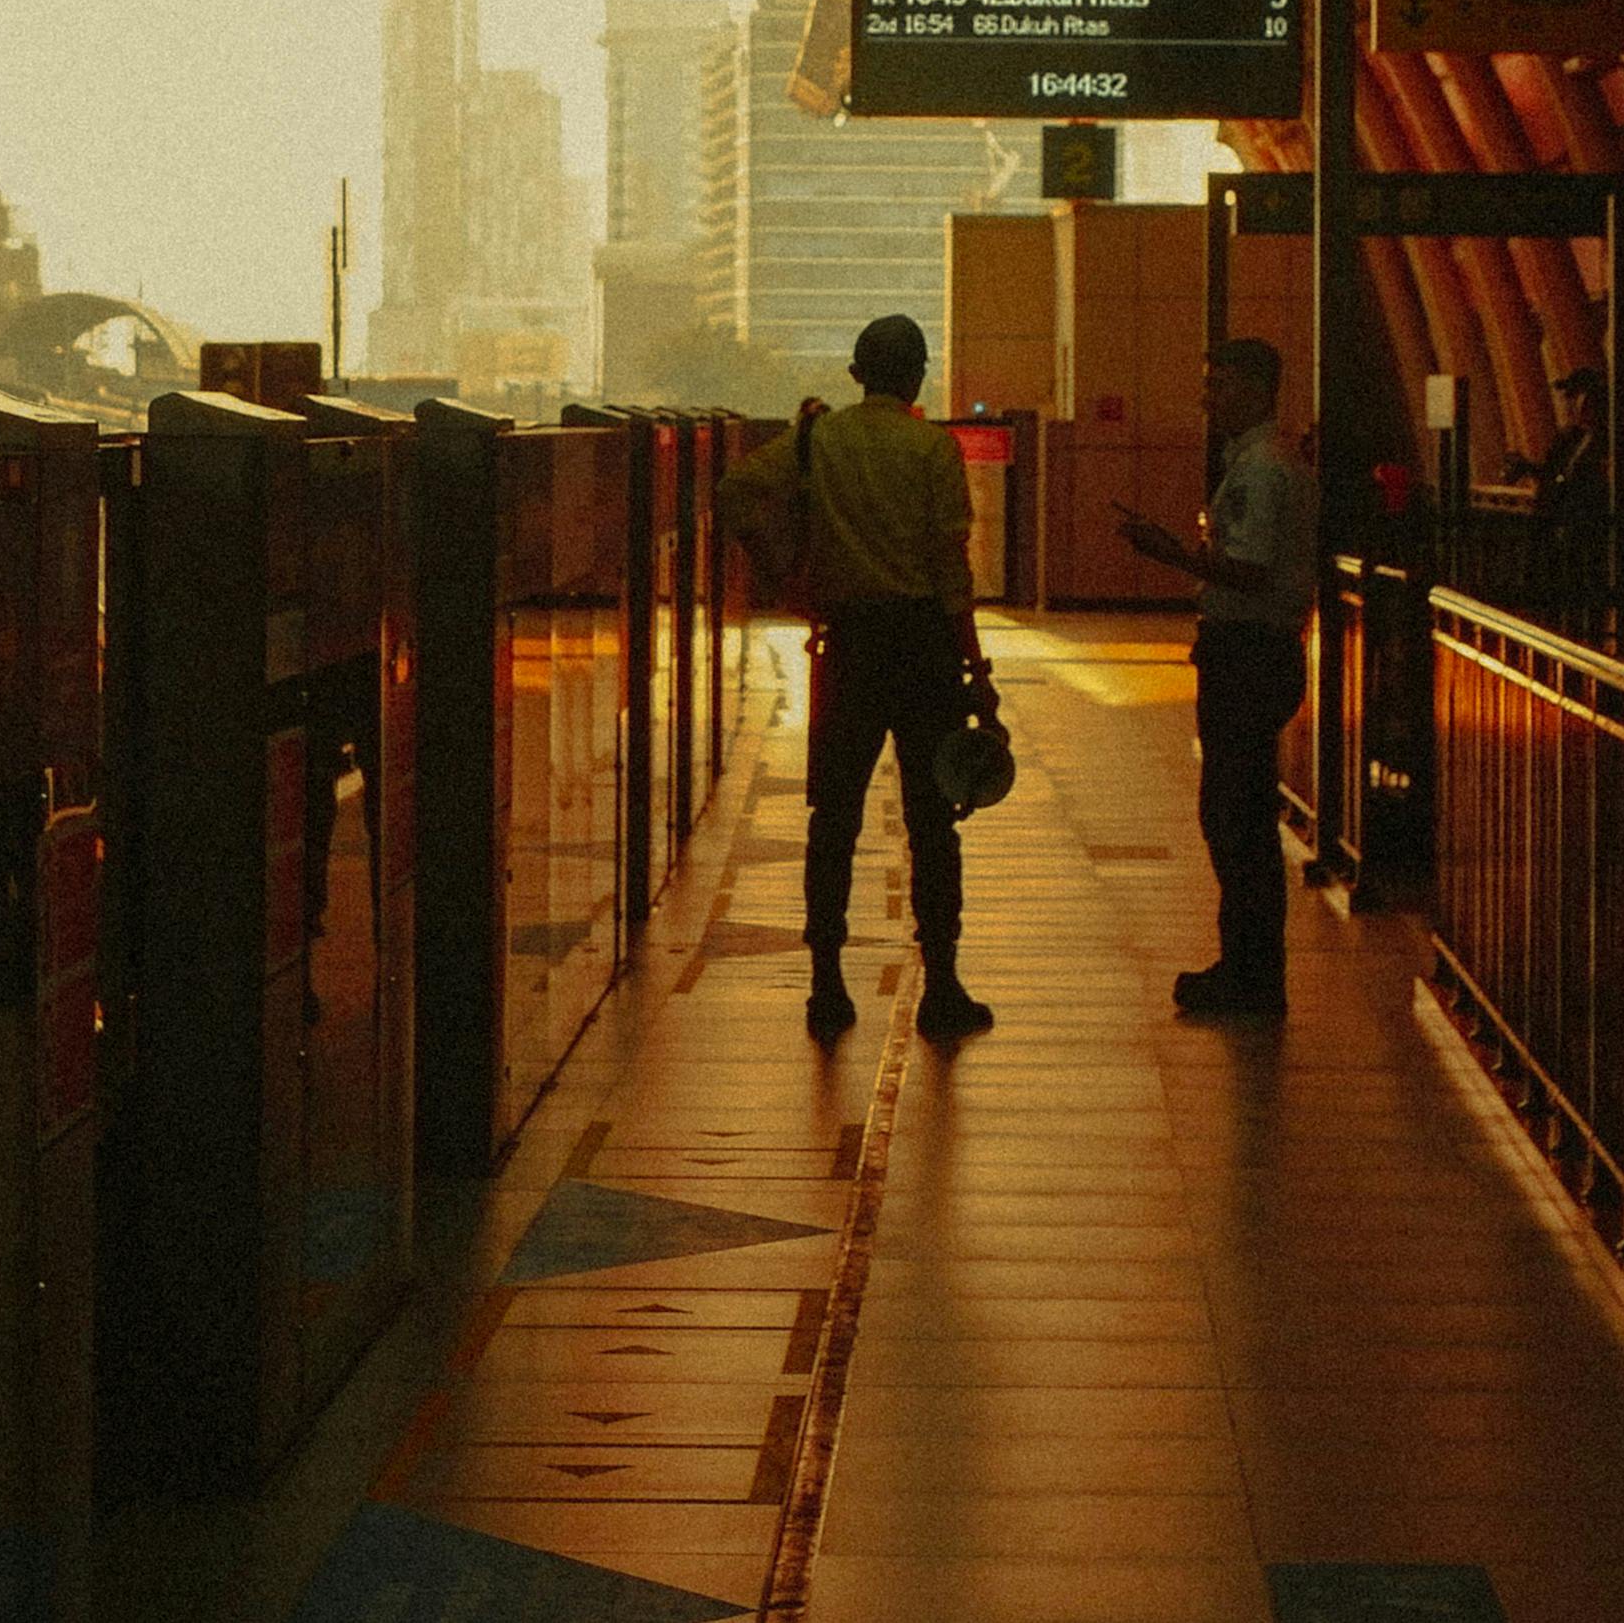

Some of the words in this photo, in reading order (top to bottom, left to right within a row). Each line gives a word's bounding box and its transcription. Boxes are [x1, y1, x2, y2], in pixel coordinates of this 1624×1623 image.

[1063, 14, 1110, 36] Atas
[1265, 16, 1288, 38] 10
[1030, 72, 1128, 97] 16:44:32
